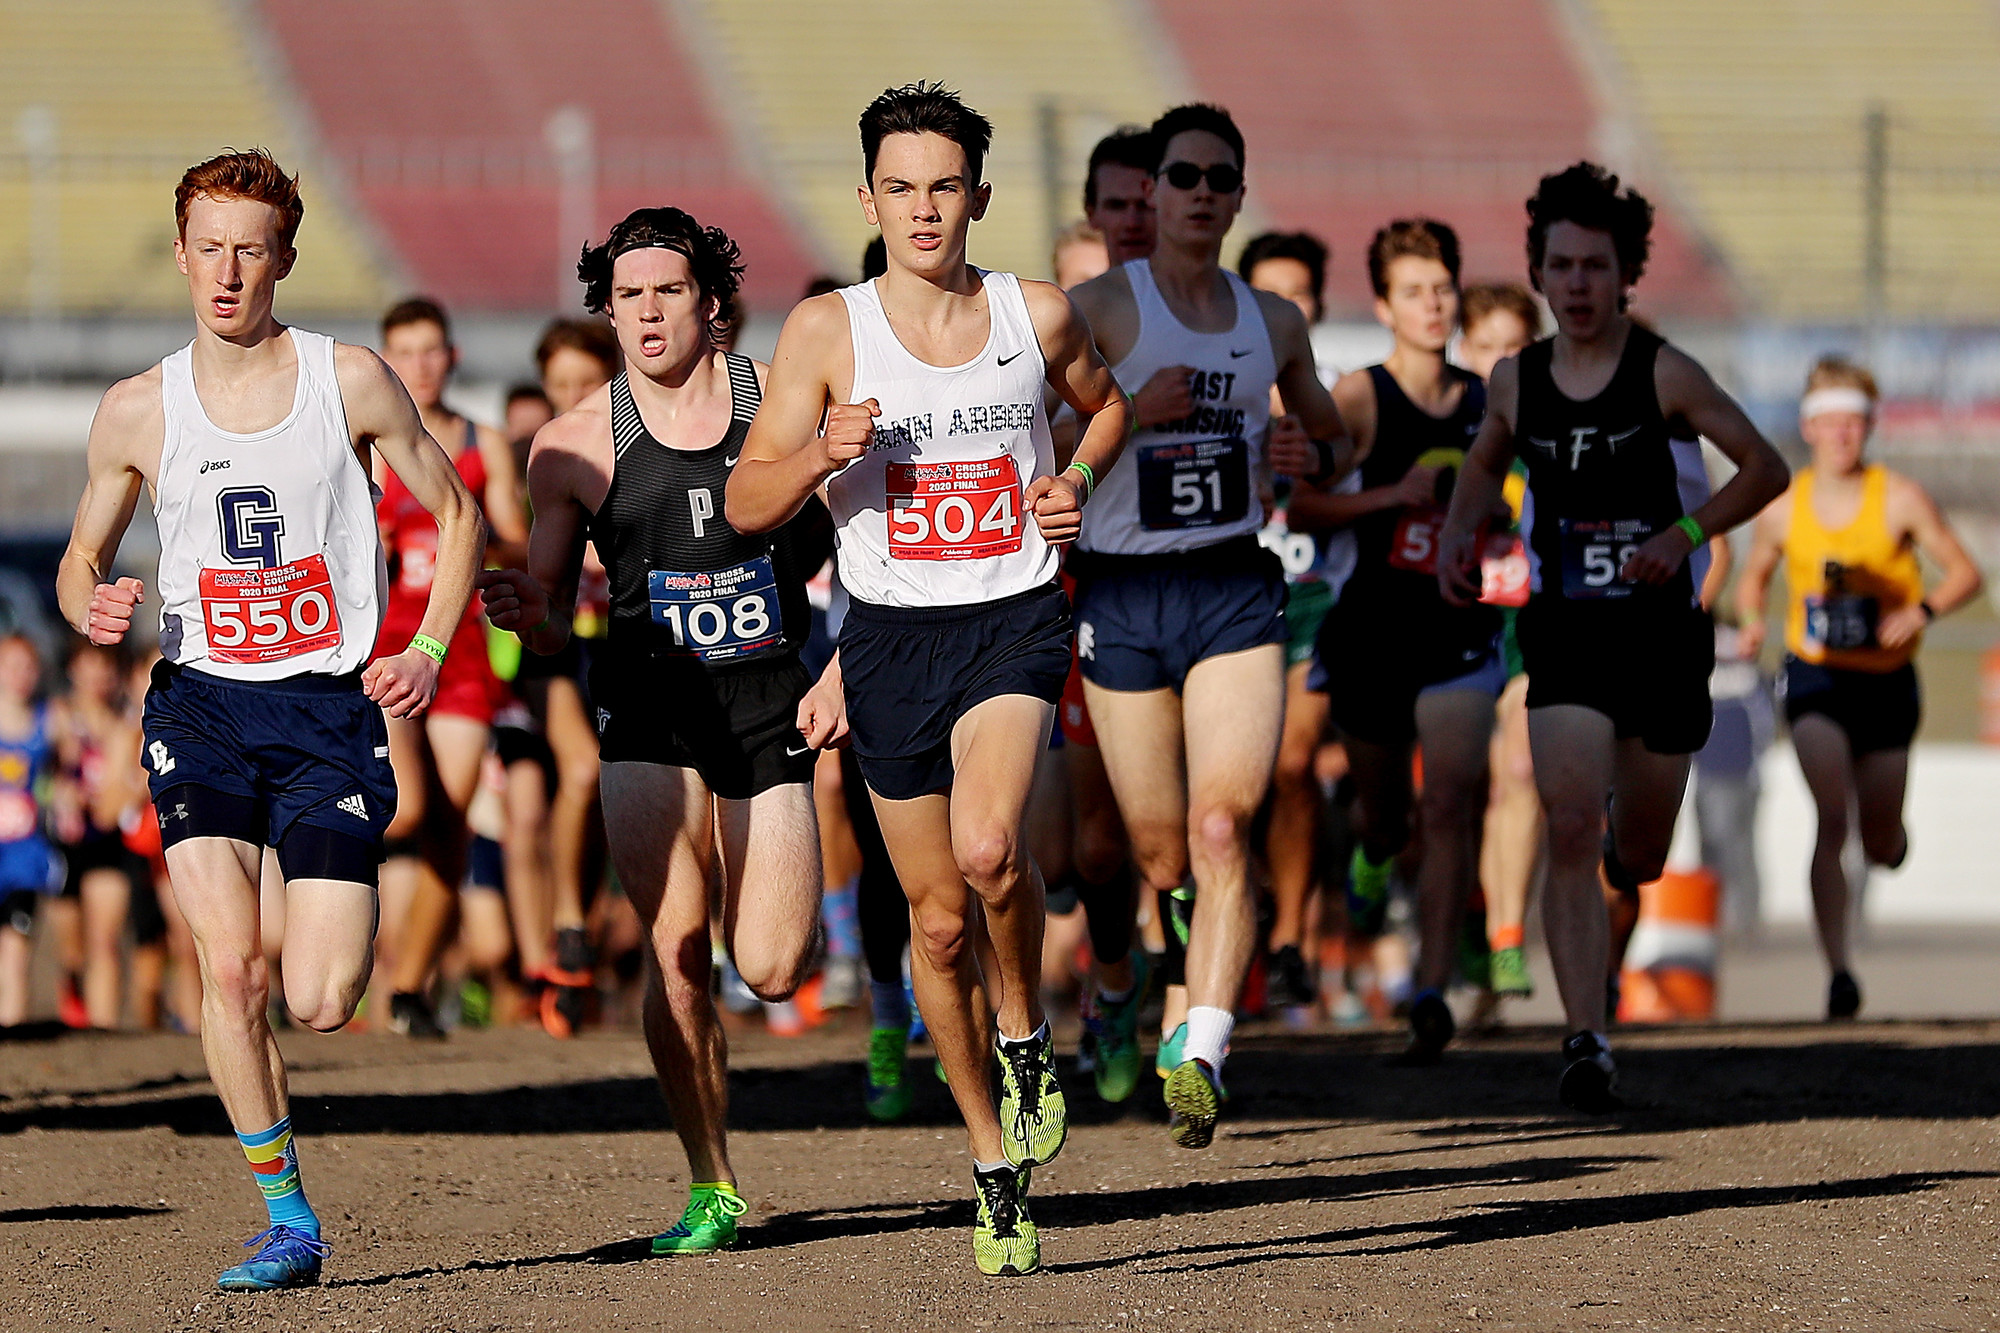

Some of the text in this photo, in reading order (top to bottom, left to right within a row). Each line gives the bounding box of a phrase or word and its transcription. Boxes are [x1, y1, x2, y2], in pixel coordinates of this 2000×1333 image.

[1189, 371, 1236, 401] AST
[873, 403, 1035, 451] ANN ARBOR
[1570, 427, 1599, 470] F
[210, 460, 231, 471] asics
[955, 463, 989, 472] CROSS
[955, 468, 1001, 479] COUNTRY
[928, 481, 980, 492] 2020 FINAL
[1171, 469, 1223, 516] 51
[687, 488, 715, 538] P
[892, 490, 1018, 544] 504
[262, 565, 297, 579] CROSS
[263, 569, 309, 586] COUNTRY
[713, 567, 745, 580] CROSS
[714, 570, 756, 587] COUNTRY
[239, 585, 290, 597] 2020 FINAL
[689, 585, 738, 600] 2020 FINAL
[210, 591, 331, 647] 550
[662, 595, 770, 646] 108
[336, 800, 370, 821] adidas
